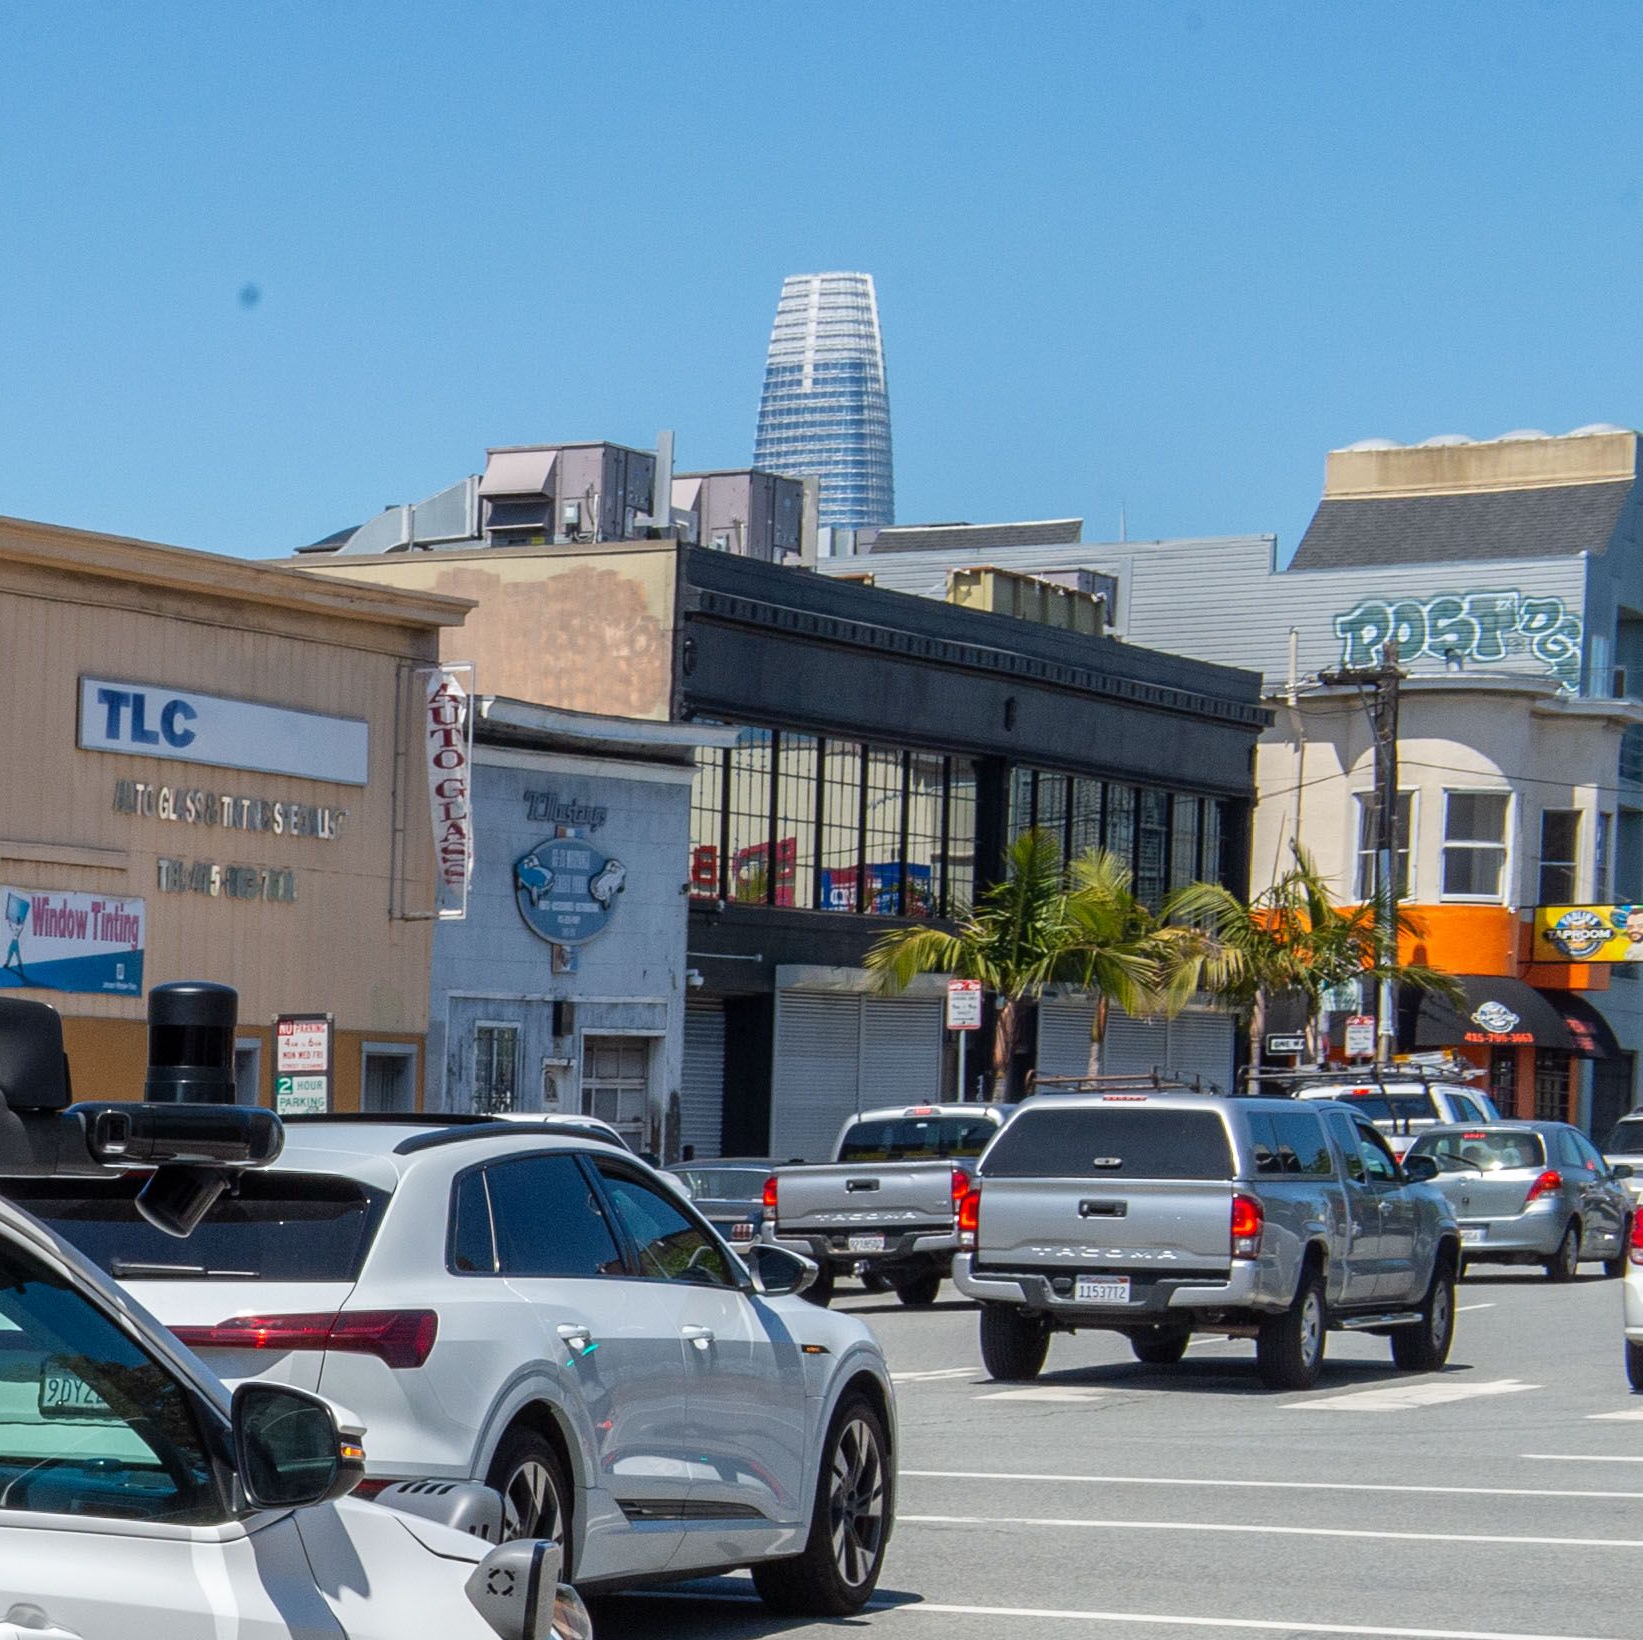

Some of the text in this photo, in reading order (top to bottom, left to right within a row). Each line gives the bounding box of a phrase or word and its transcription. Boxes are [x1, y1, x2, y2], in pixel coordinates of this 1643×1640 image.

[97, 687, 198, 748] TLC
[428, 682, 465, 770] AUTO
[158, 786, 205, 824] GLASS
[31, 895, 140, 952] Window Tinting
[1547, 929, 1611, 940] TAPROOM
[279, 1024, 325, 1035] NO PARKING
[279, 1077, 323, 1094] 2 HOUR
[279, 1097, 325, 1107] PARKING
[814, 1211, 917, 1222] TACOMA
[1031, 1245, 1178, 1260] TACOMA
[1078, 1285, 1127, 1299] 11537T2
[47, 1379, 103, 1404] 9DYZ
